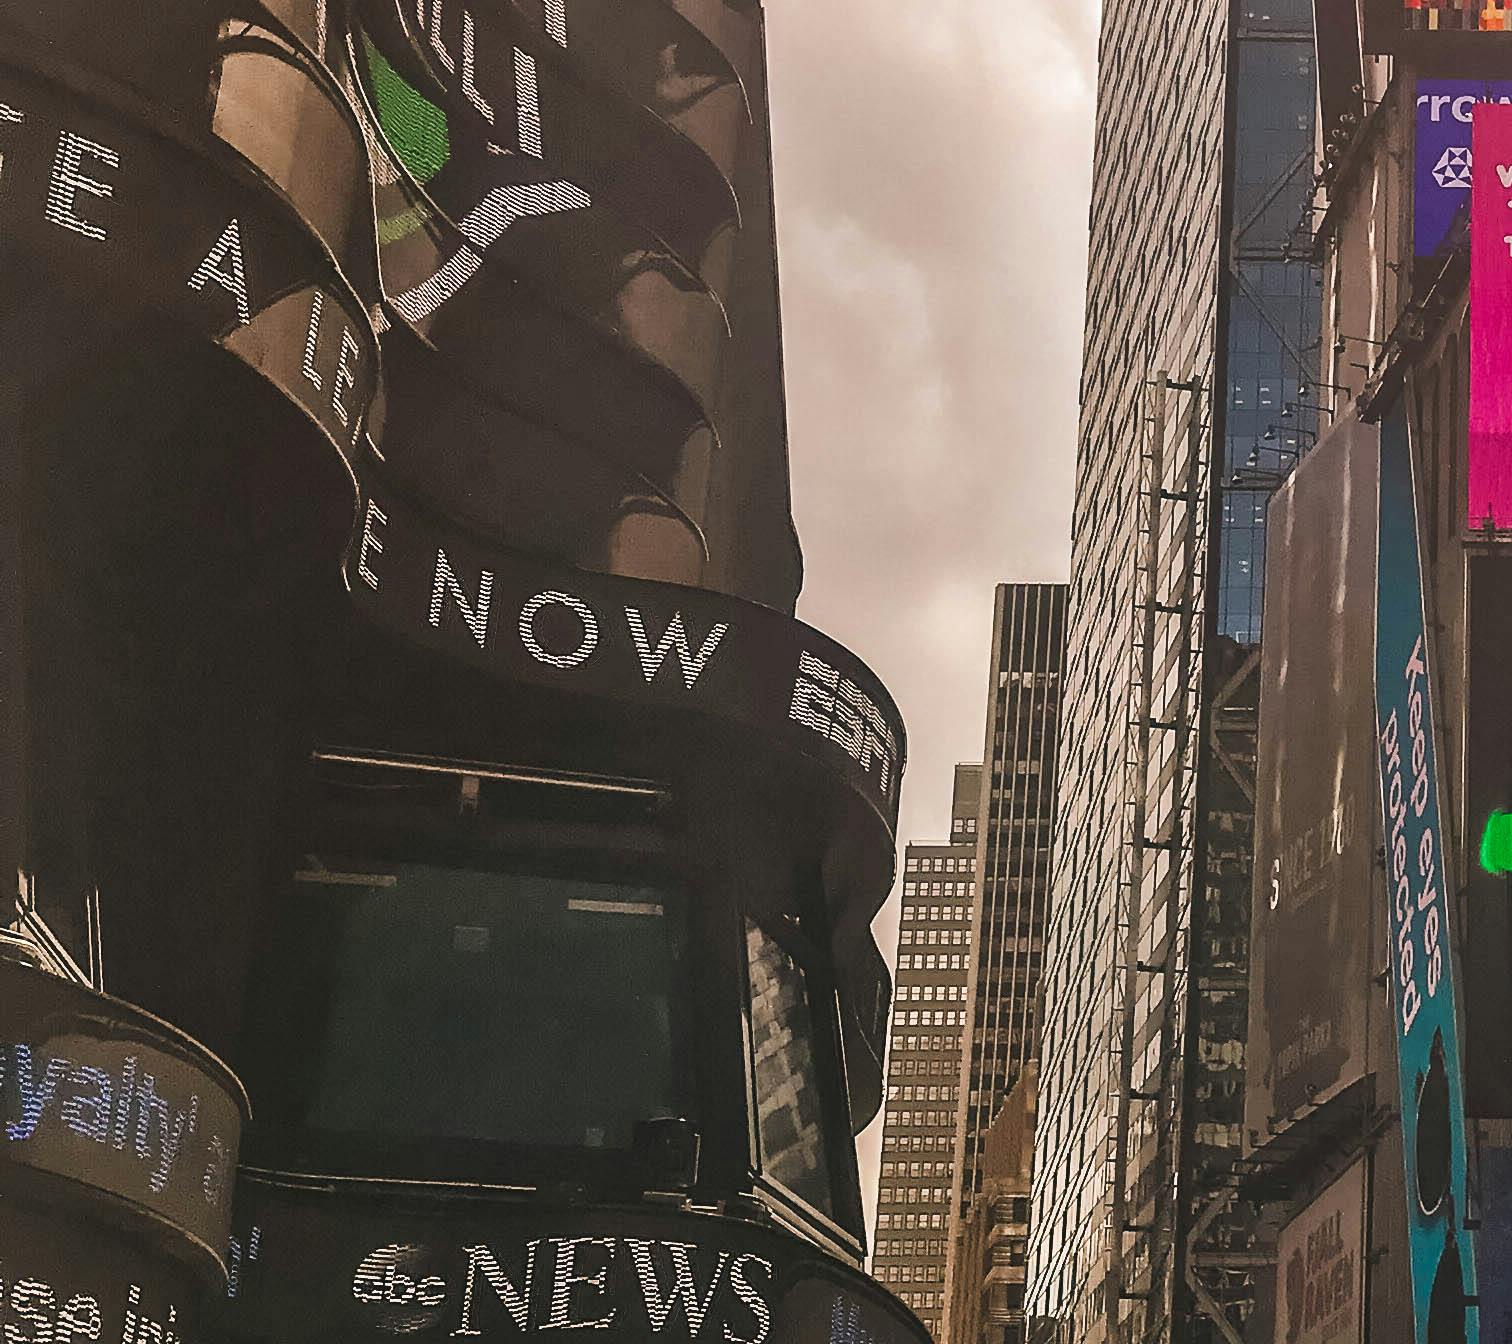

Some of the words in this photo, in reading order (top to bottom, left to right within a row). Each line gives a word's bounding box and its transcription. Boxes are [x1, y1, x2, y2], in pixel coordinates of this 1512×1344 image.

[428, 548, 729, 690] NOW
[1405, 634, 1430, 817] Keep
[1380, 708, 1421, 1037] protected
[1417, 827, 1442, 998] eyes
[2, 1043, 188, 1194] yalty
